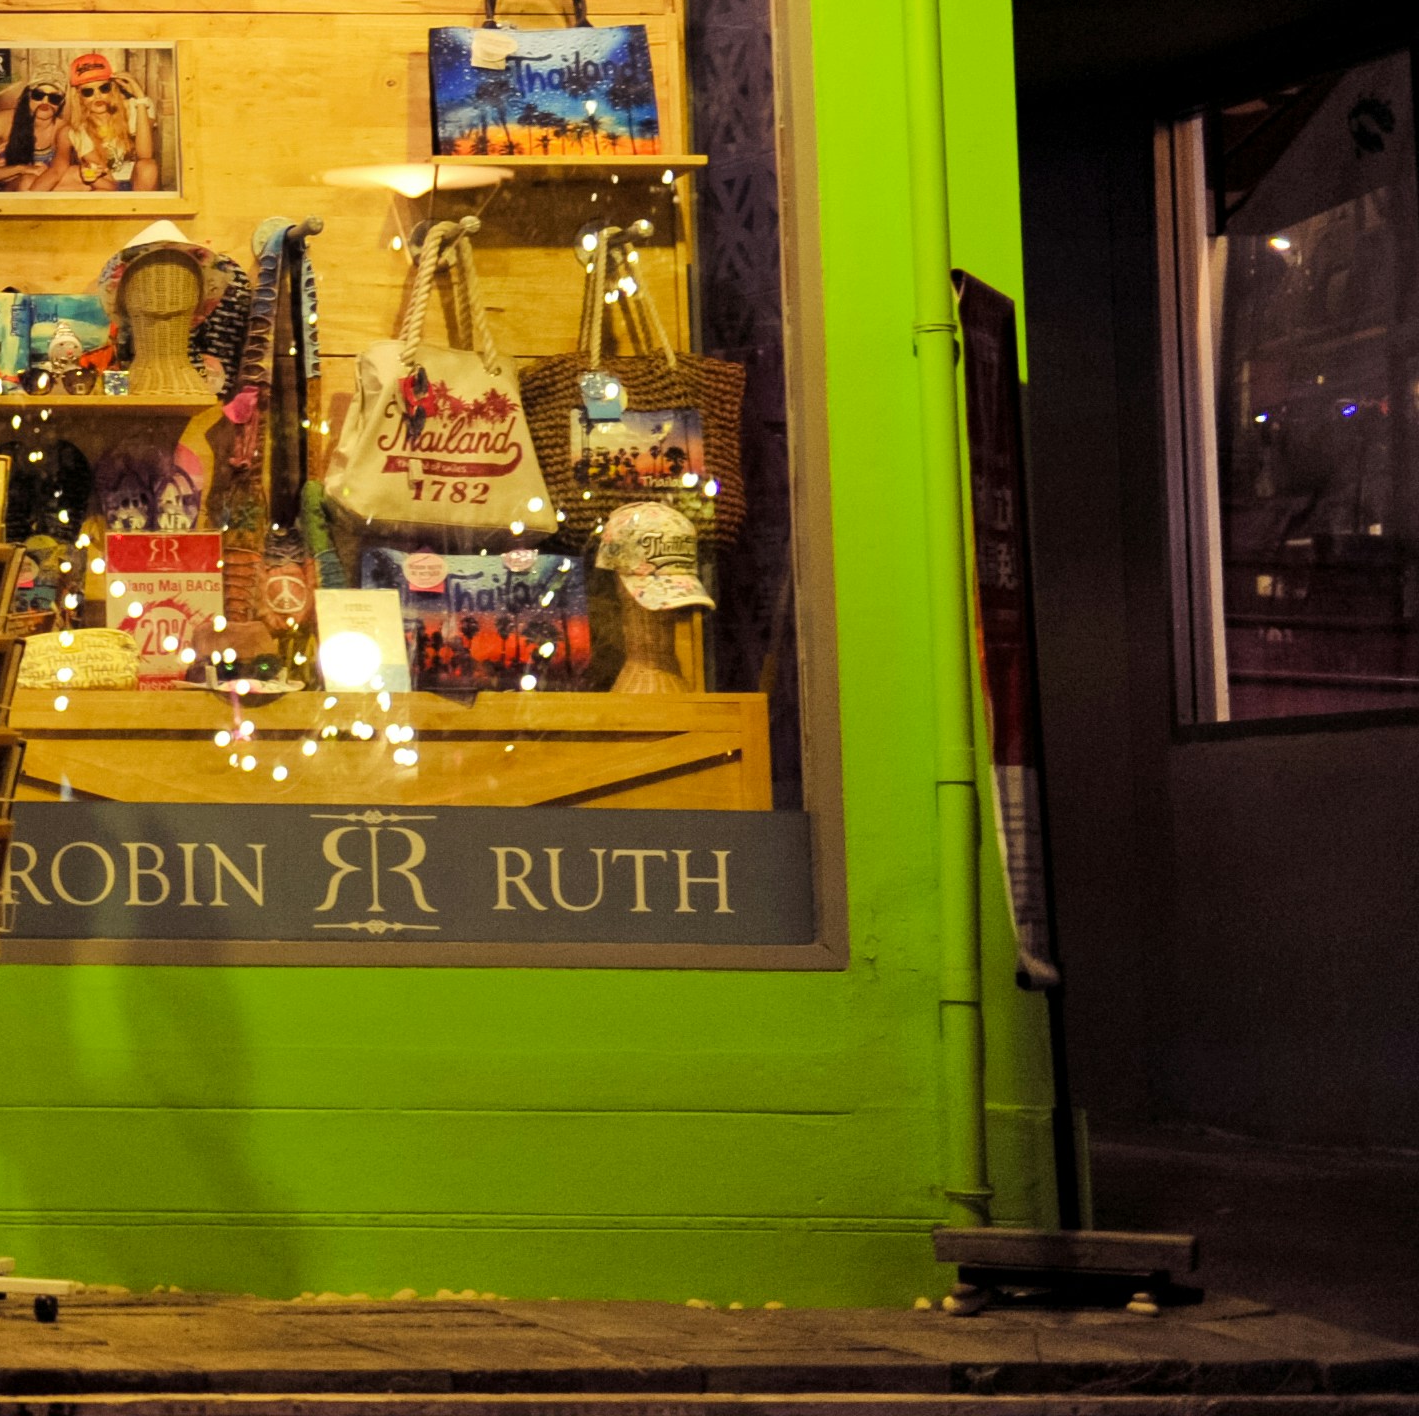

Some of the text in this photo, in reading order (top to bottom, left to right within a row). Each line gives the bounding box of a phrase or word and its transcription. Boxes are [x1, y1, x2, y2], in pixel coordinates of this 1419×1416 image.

[411, 479, 491, 505] 1782
[1, 841, 267, 908] ROBIN
[489, 844, 736, 915] RUTH
